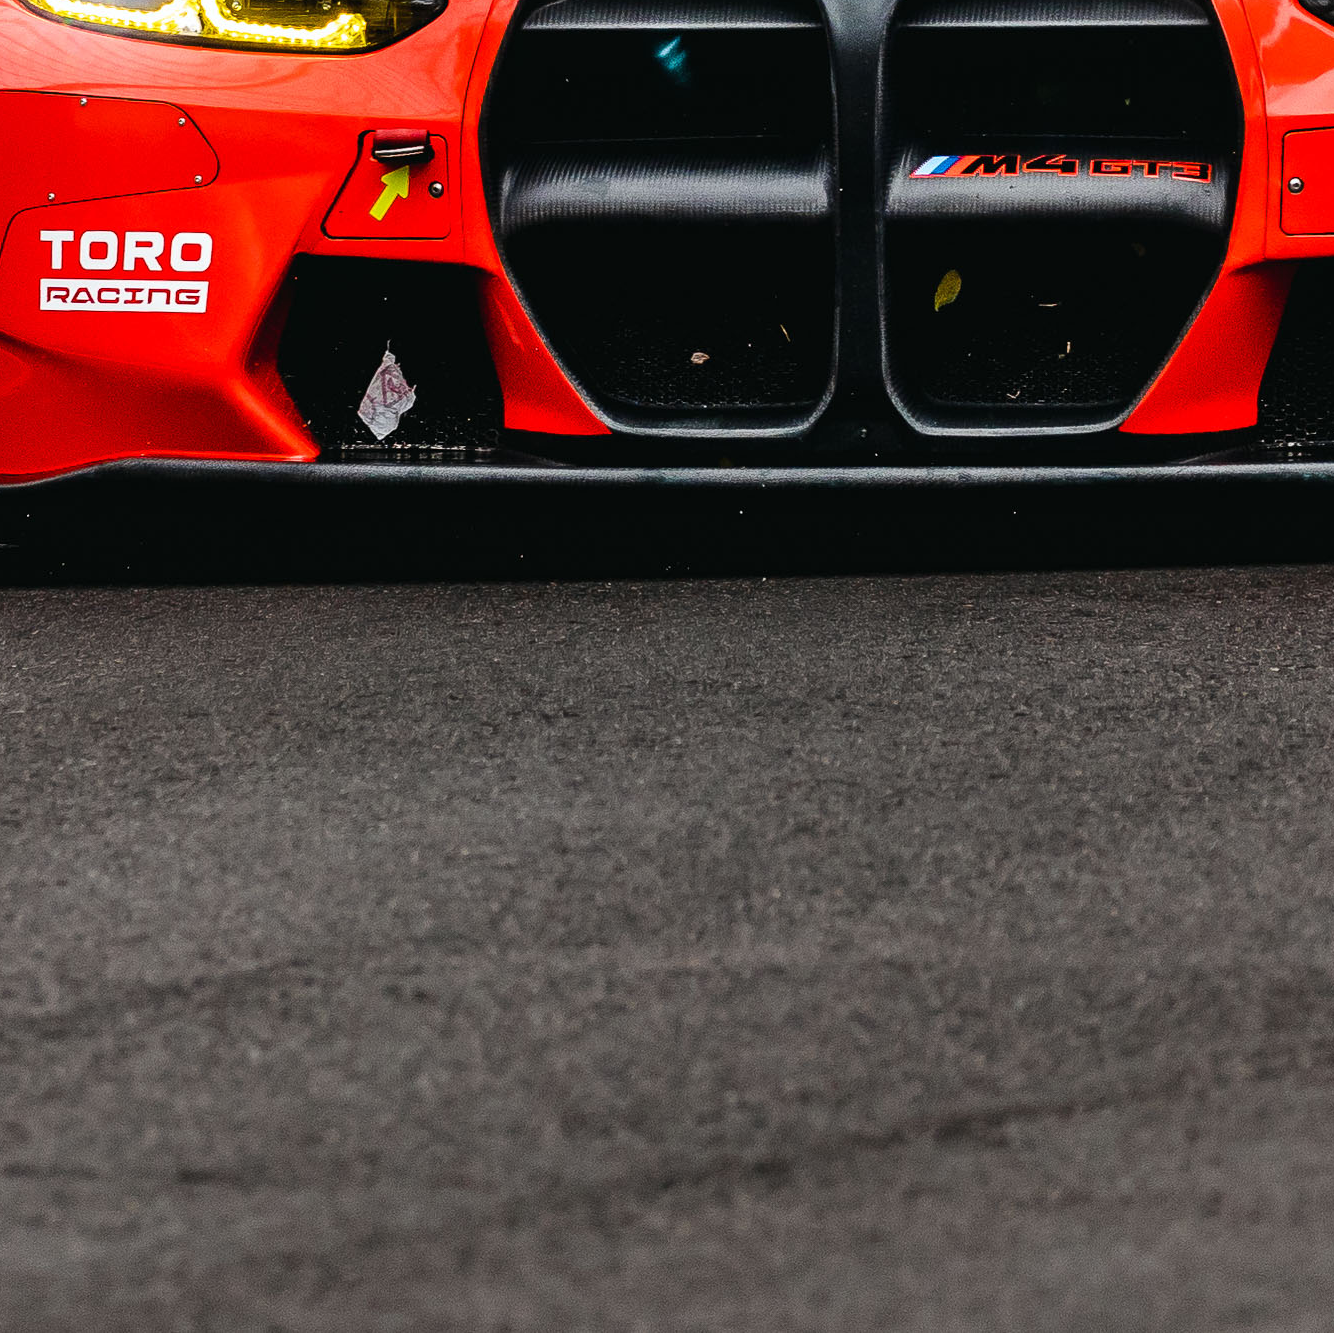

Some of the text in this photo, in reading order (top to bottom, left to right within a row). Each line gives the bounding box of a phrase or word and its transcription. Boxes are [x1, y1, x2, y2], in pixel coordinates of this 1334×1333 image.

[956, 154, 1213, 184] M4 GT3
[39, 229, 214, 273] TORO
[45, 284, 202, 307] RACING
